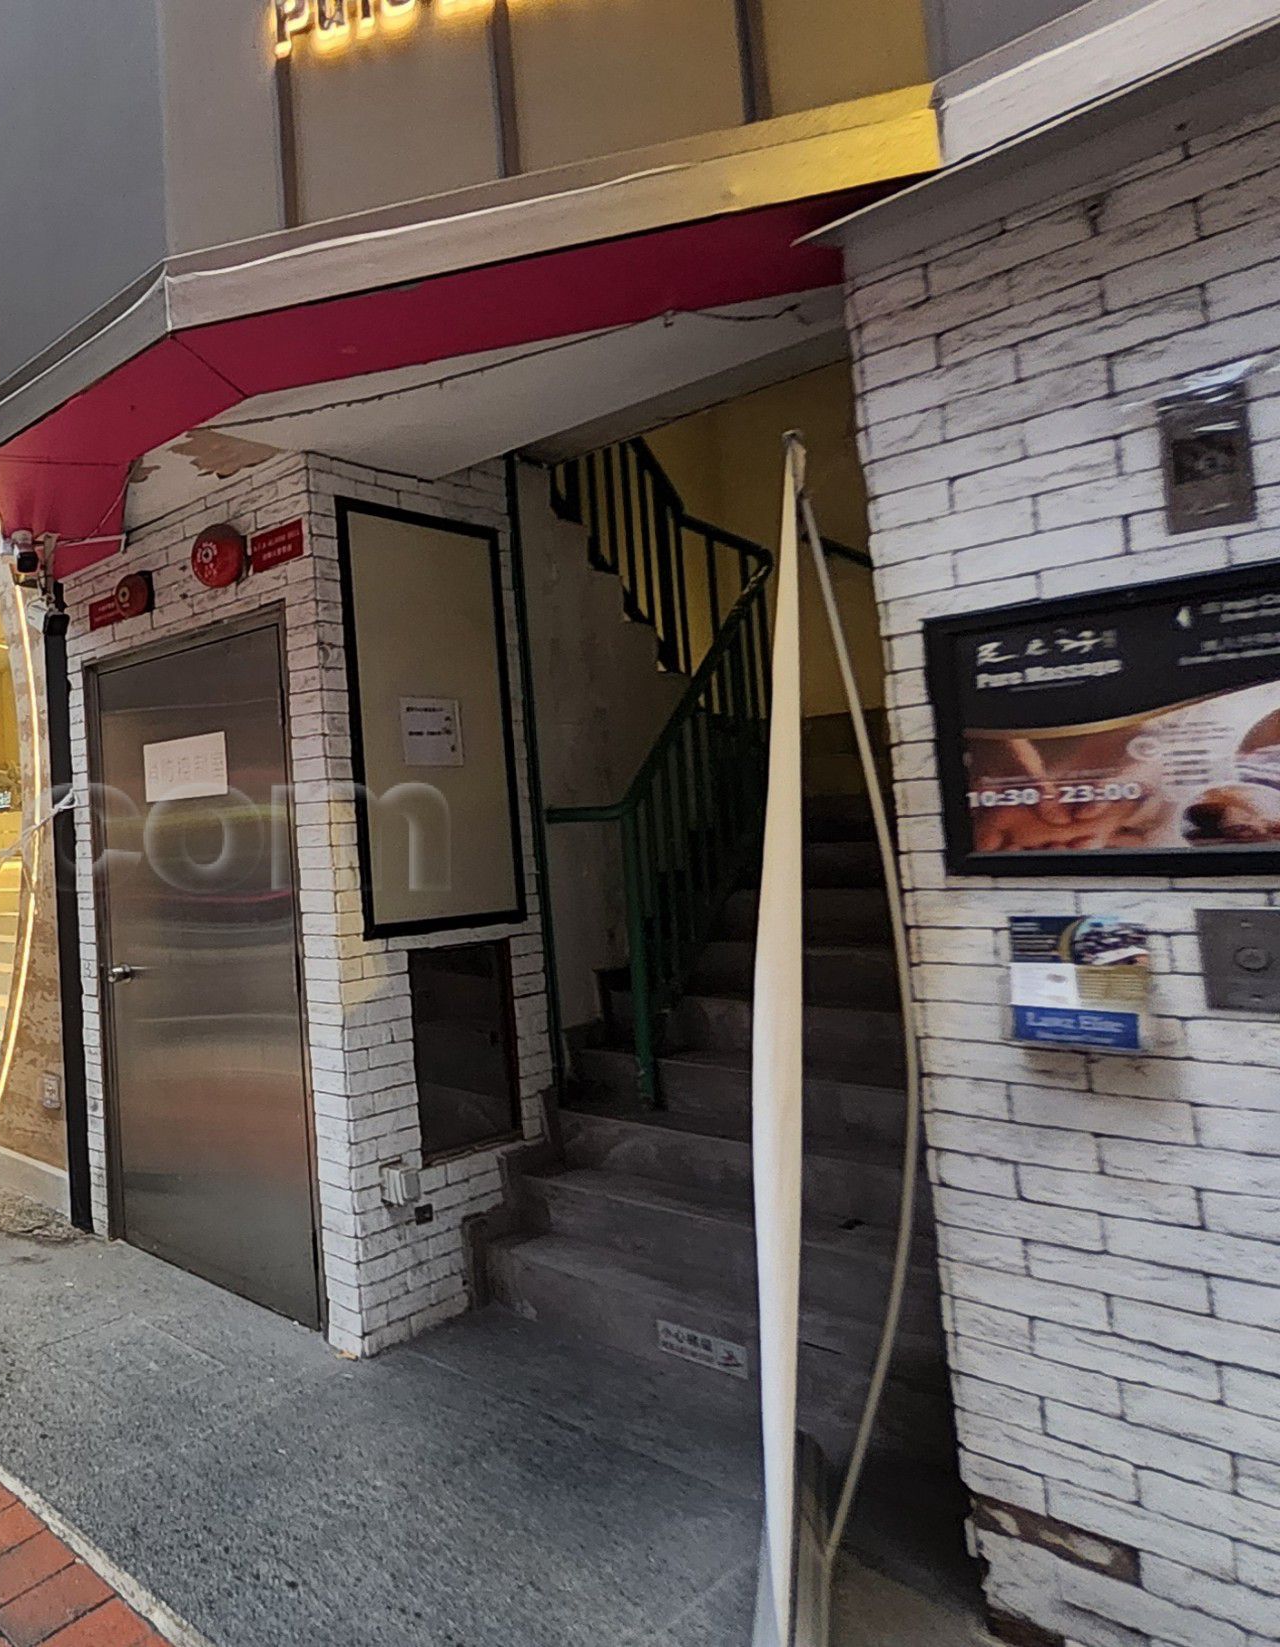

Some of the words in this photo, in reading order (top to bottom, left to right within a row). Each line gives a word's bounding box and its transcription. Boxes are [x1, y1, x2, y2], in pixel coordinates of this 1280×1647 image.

[274, 0, 416, 54] Pu
[965, 788, 1040, 809] 10:30
[1058, 782, 1143, 805] 23:00
